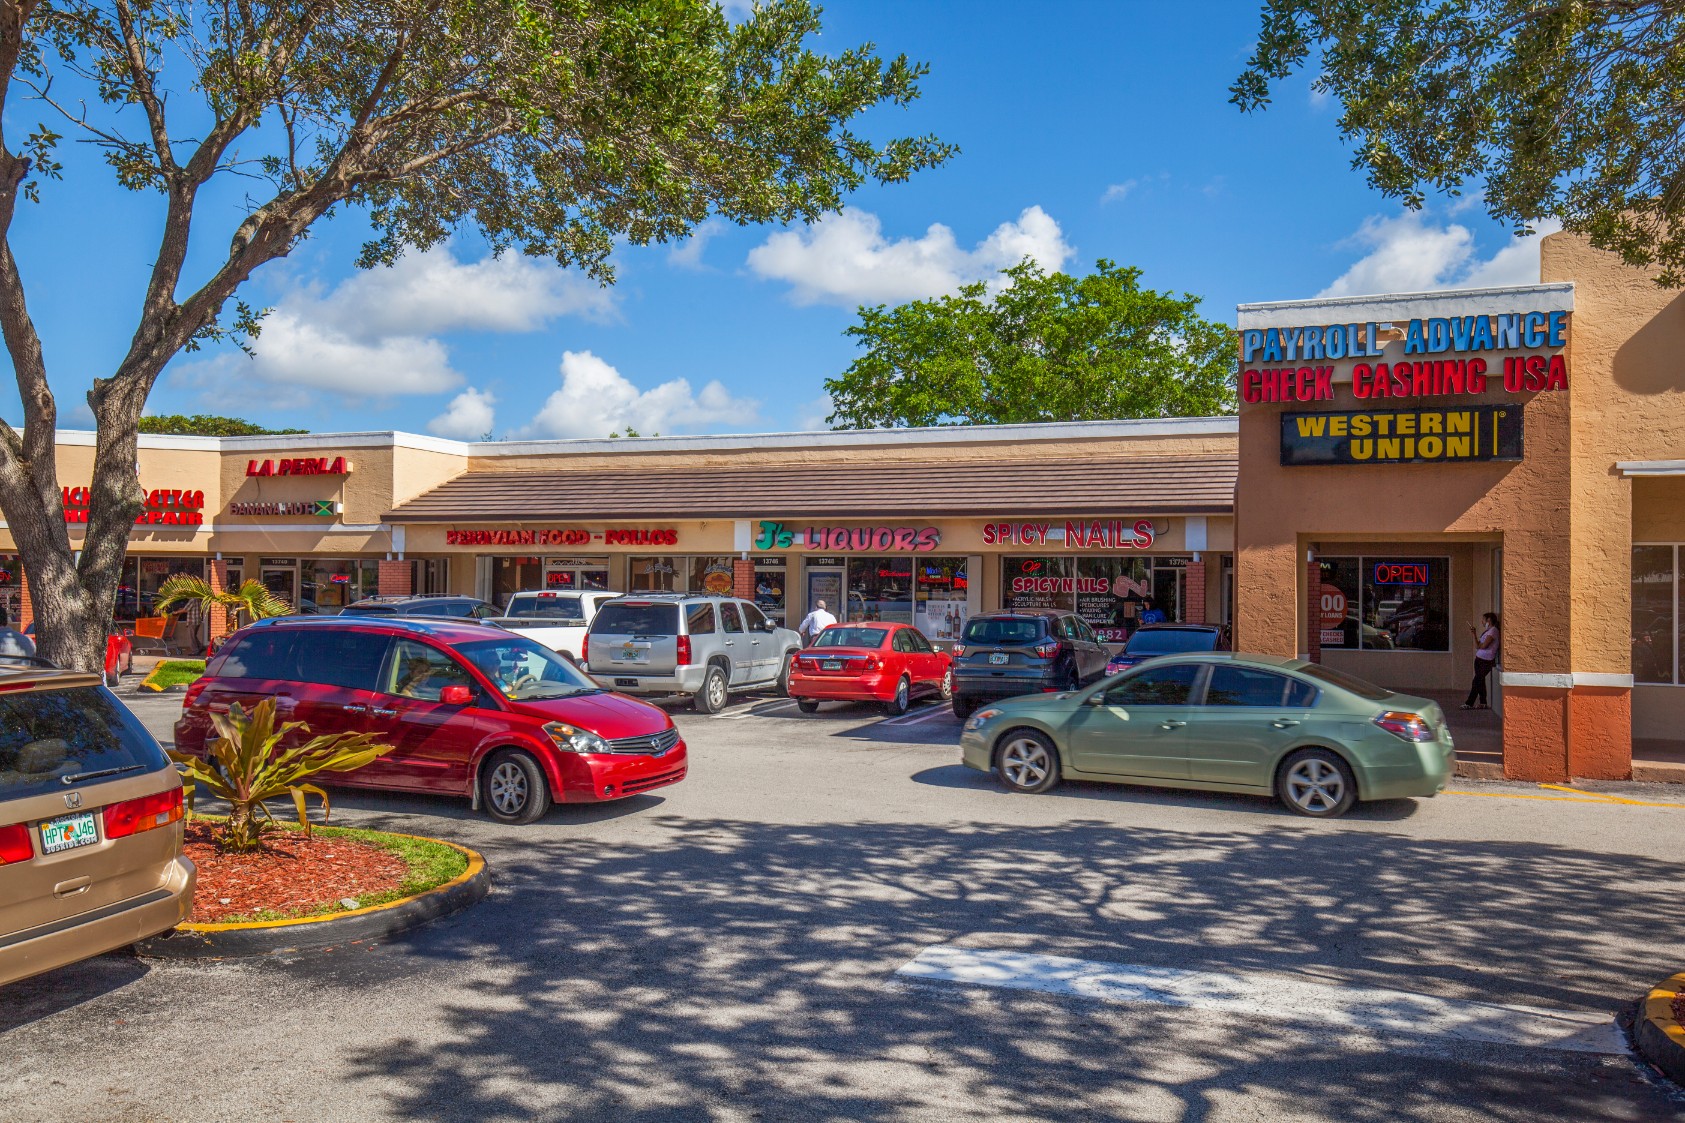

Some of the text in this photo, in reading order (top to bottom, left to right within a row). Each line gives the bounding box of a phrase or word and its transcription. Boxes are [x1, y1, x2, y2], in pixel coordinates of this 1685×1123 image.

[1243, 310, 1567, 363] PAYROLL ADVANCE
[1243, 354, 1569, 404] CHECK CASHING USA
[1296, 411, 1470, 438] WESTERN
[1350, 435, 1470, 460] UNION
[246, 456, 347, 477] LA PERLA
[134, 510, 203, 525] EPAIR
[230, 502, 312, 516] BANANA HUT
[446, 529, 536, 545] PERUVIAN
[538, 529, 591, 545] FOOD
[605, 529, 678, 546] POLLOS
[803, 526, 940, 551] LIQUORS
[982, 520, 1154, 549] SPICY NAILS
[547, 573, 571, 584] OPEN
[1377, 564, 1427, 583] OPEN
[1013, 577, 1109, 593] SPICY NAILS
